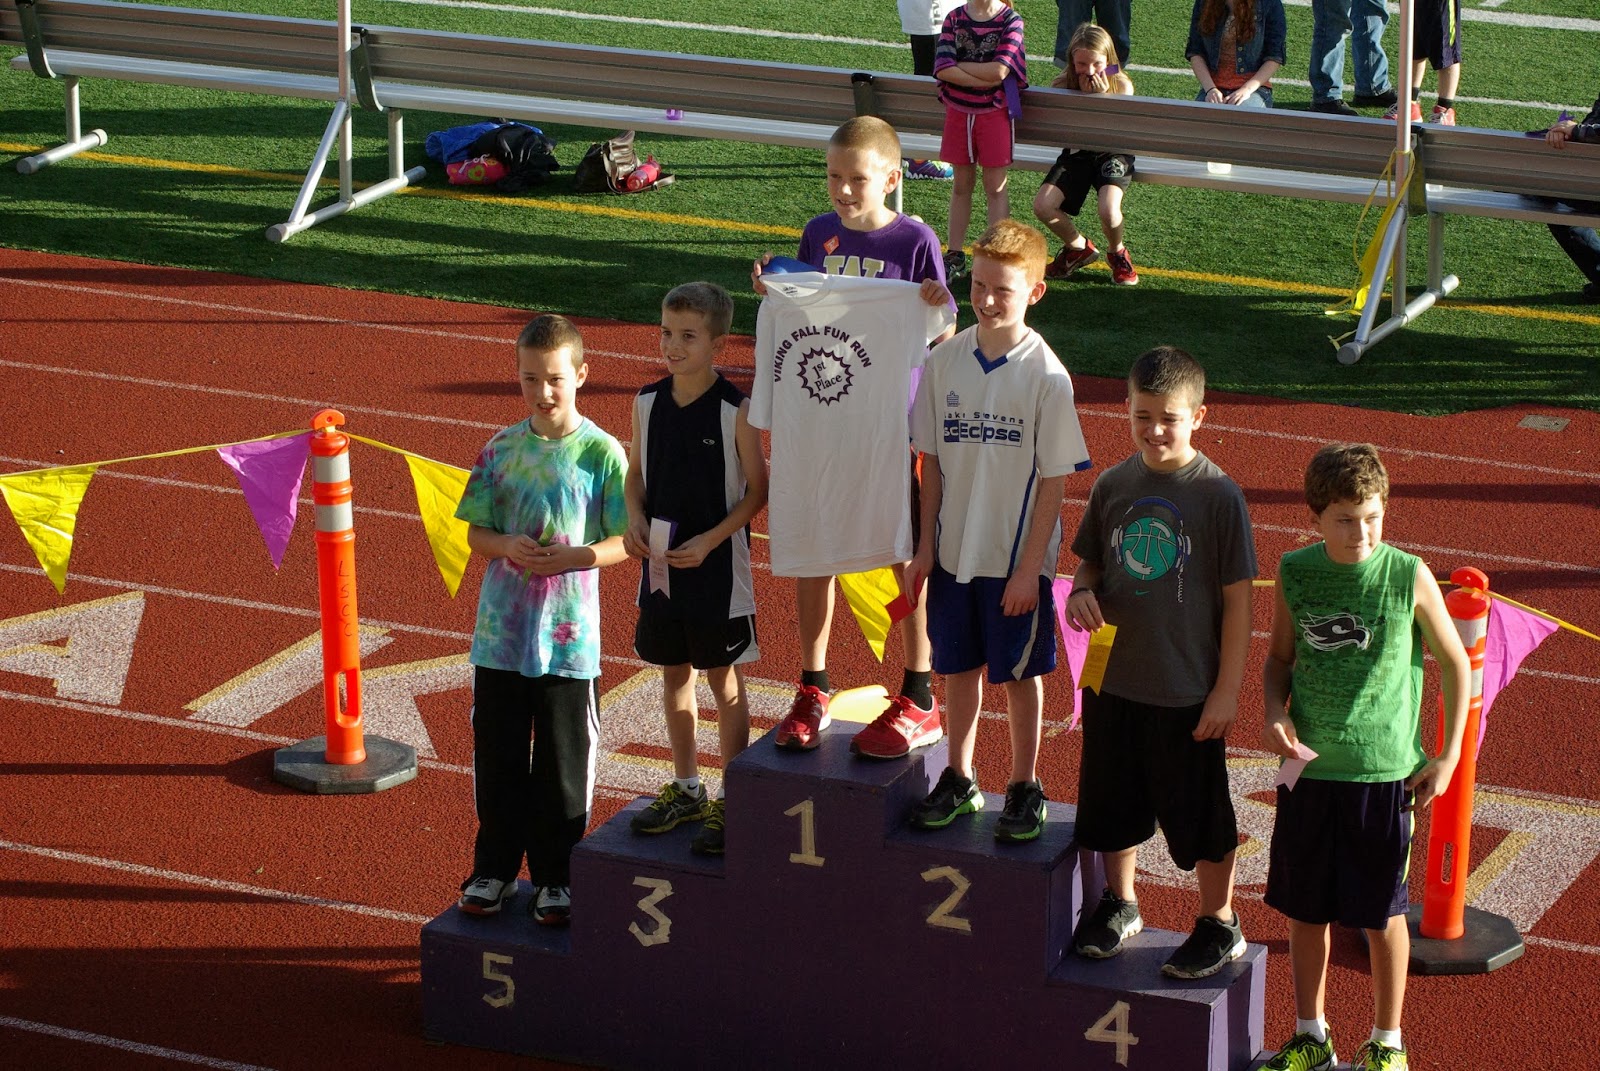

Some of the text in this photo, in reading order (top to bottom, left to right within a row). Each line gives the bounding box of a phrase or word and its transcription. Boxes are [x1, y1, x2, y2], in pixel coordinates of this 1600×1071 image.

[774, 325, 872, 382] VIKING FALL FUN RUN
[812, 361, 827, 379] 1st
[814, 374, 843, 391] Place
[944, 411, 1024, 425] ak Sevens
[960, 422, 1021, 443] Eclpse
[783, 797, 825, 867] 1
[628, 875, 674, 947] 3
[920, 864, 972, 936] 2
[481, 951, 516, 1009] 5
[1084, 1000, 1139, 1067] 4
